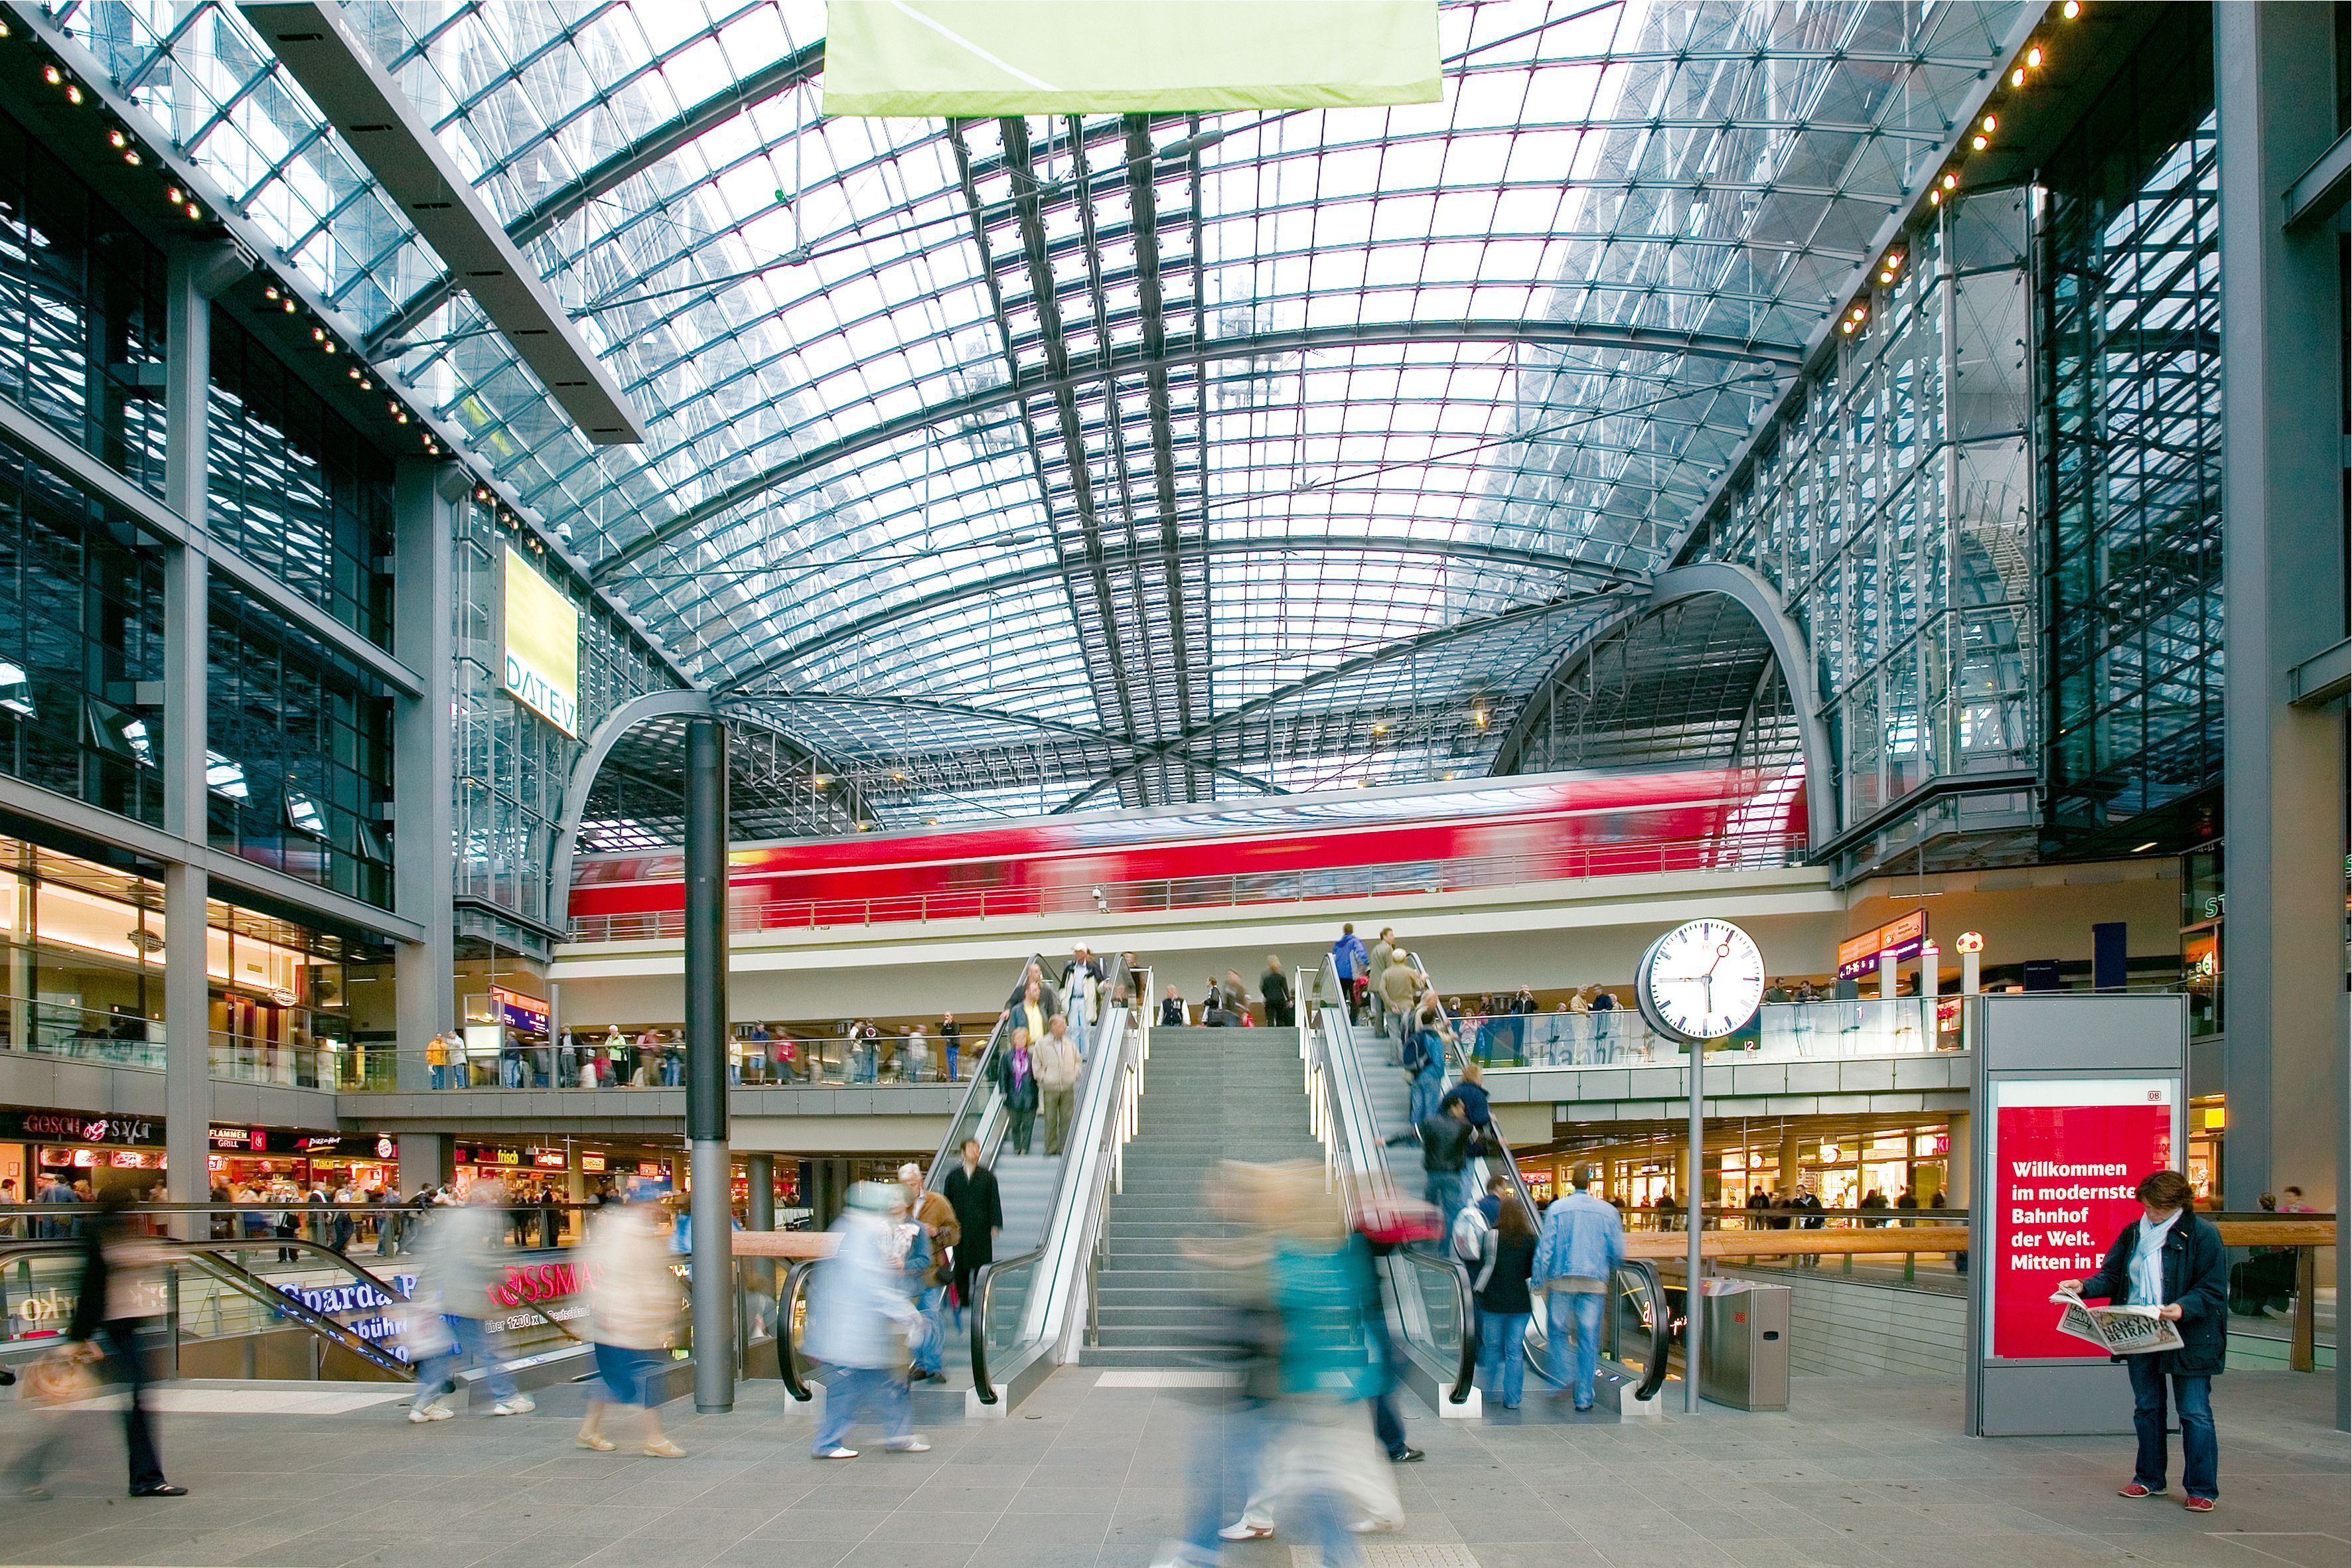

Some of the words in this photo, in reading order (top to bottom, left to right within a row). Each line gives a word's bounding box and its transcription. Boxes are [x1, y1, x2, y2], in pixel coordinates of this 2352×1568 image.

[506, 654, 575, 729] DATEV
[25, 1115, 80, 1135] GOSCH
[209, 1129, 248, 1139] FLAMMEN
[218, 1139, 239, 1148] GRILL
[2012, 1161, 2127, 1177] Willkommen
[2012, 1184, 2033, 1200] im
[2039, 1184, 2136, 1200] modernste
[2012, 1207, 2089, 1224] Bahnhof
[2012, 1231, 2042, 1247] der
[2047, 1230, 2095, 1246] Welt.
[2012, 1254, 2071, 1270] Mitten
[2075, 1253, 2091, 1268] in
[485, 1261, 605, 1306] OSSMA
[485, 1317, 505, 1334] über
[1735, 1313, 1745, 1322] DB
[2102, 1316, 2141, 1336] NANCY
[2107, 1319, 2168, 1342] BETRAYER
